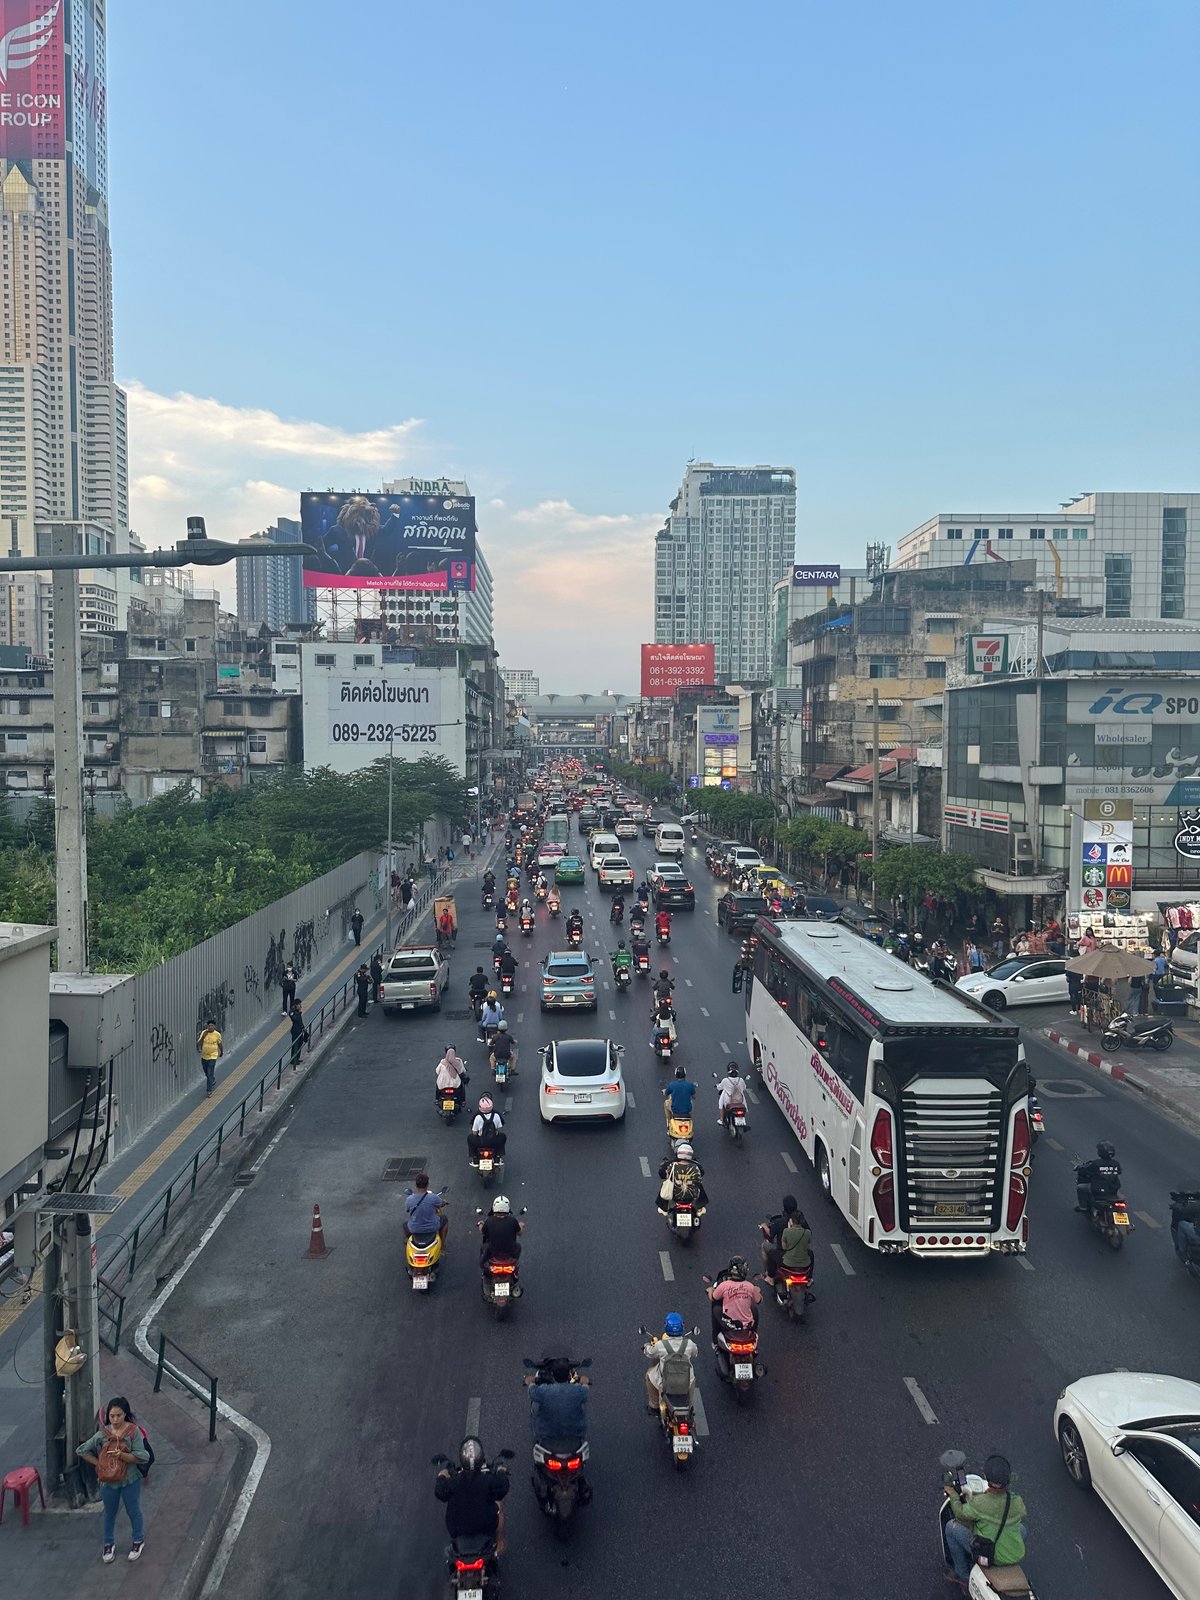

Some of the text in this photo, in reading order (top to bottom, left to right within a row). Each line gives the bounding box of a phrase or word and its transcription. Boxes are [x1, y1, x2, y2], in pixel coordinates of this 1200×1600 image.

[1, 93, 61, 109] E iCON
[1, 112, 52, 127] ROUP
[410, 481, 450, 492] INDRA
[403, 521, 467, 545] สกิลคุณ
[794, 570, 839, 579] CENTARA
[650, 652, 706, 661] สนใจติดต่อโฆษณา
[976, 640, 1000, 672] 7
[649, 666, 705, 675] 061-392-3392
[649, 678, 704, 686] 081-638-1551
[340, 679, 429, 703] ติดต่อโฆษณา
[332, 723, 437, 743] 089-232-5225
[1096, 734, 1148, 743] Wholesaler
[1075, 786, 1099, 794] mobile
[1104, 786, 1119, 794] 081
[1120, 786, 1154, 794] 8362606
